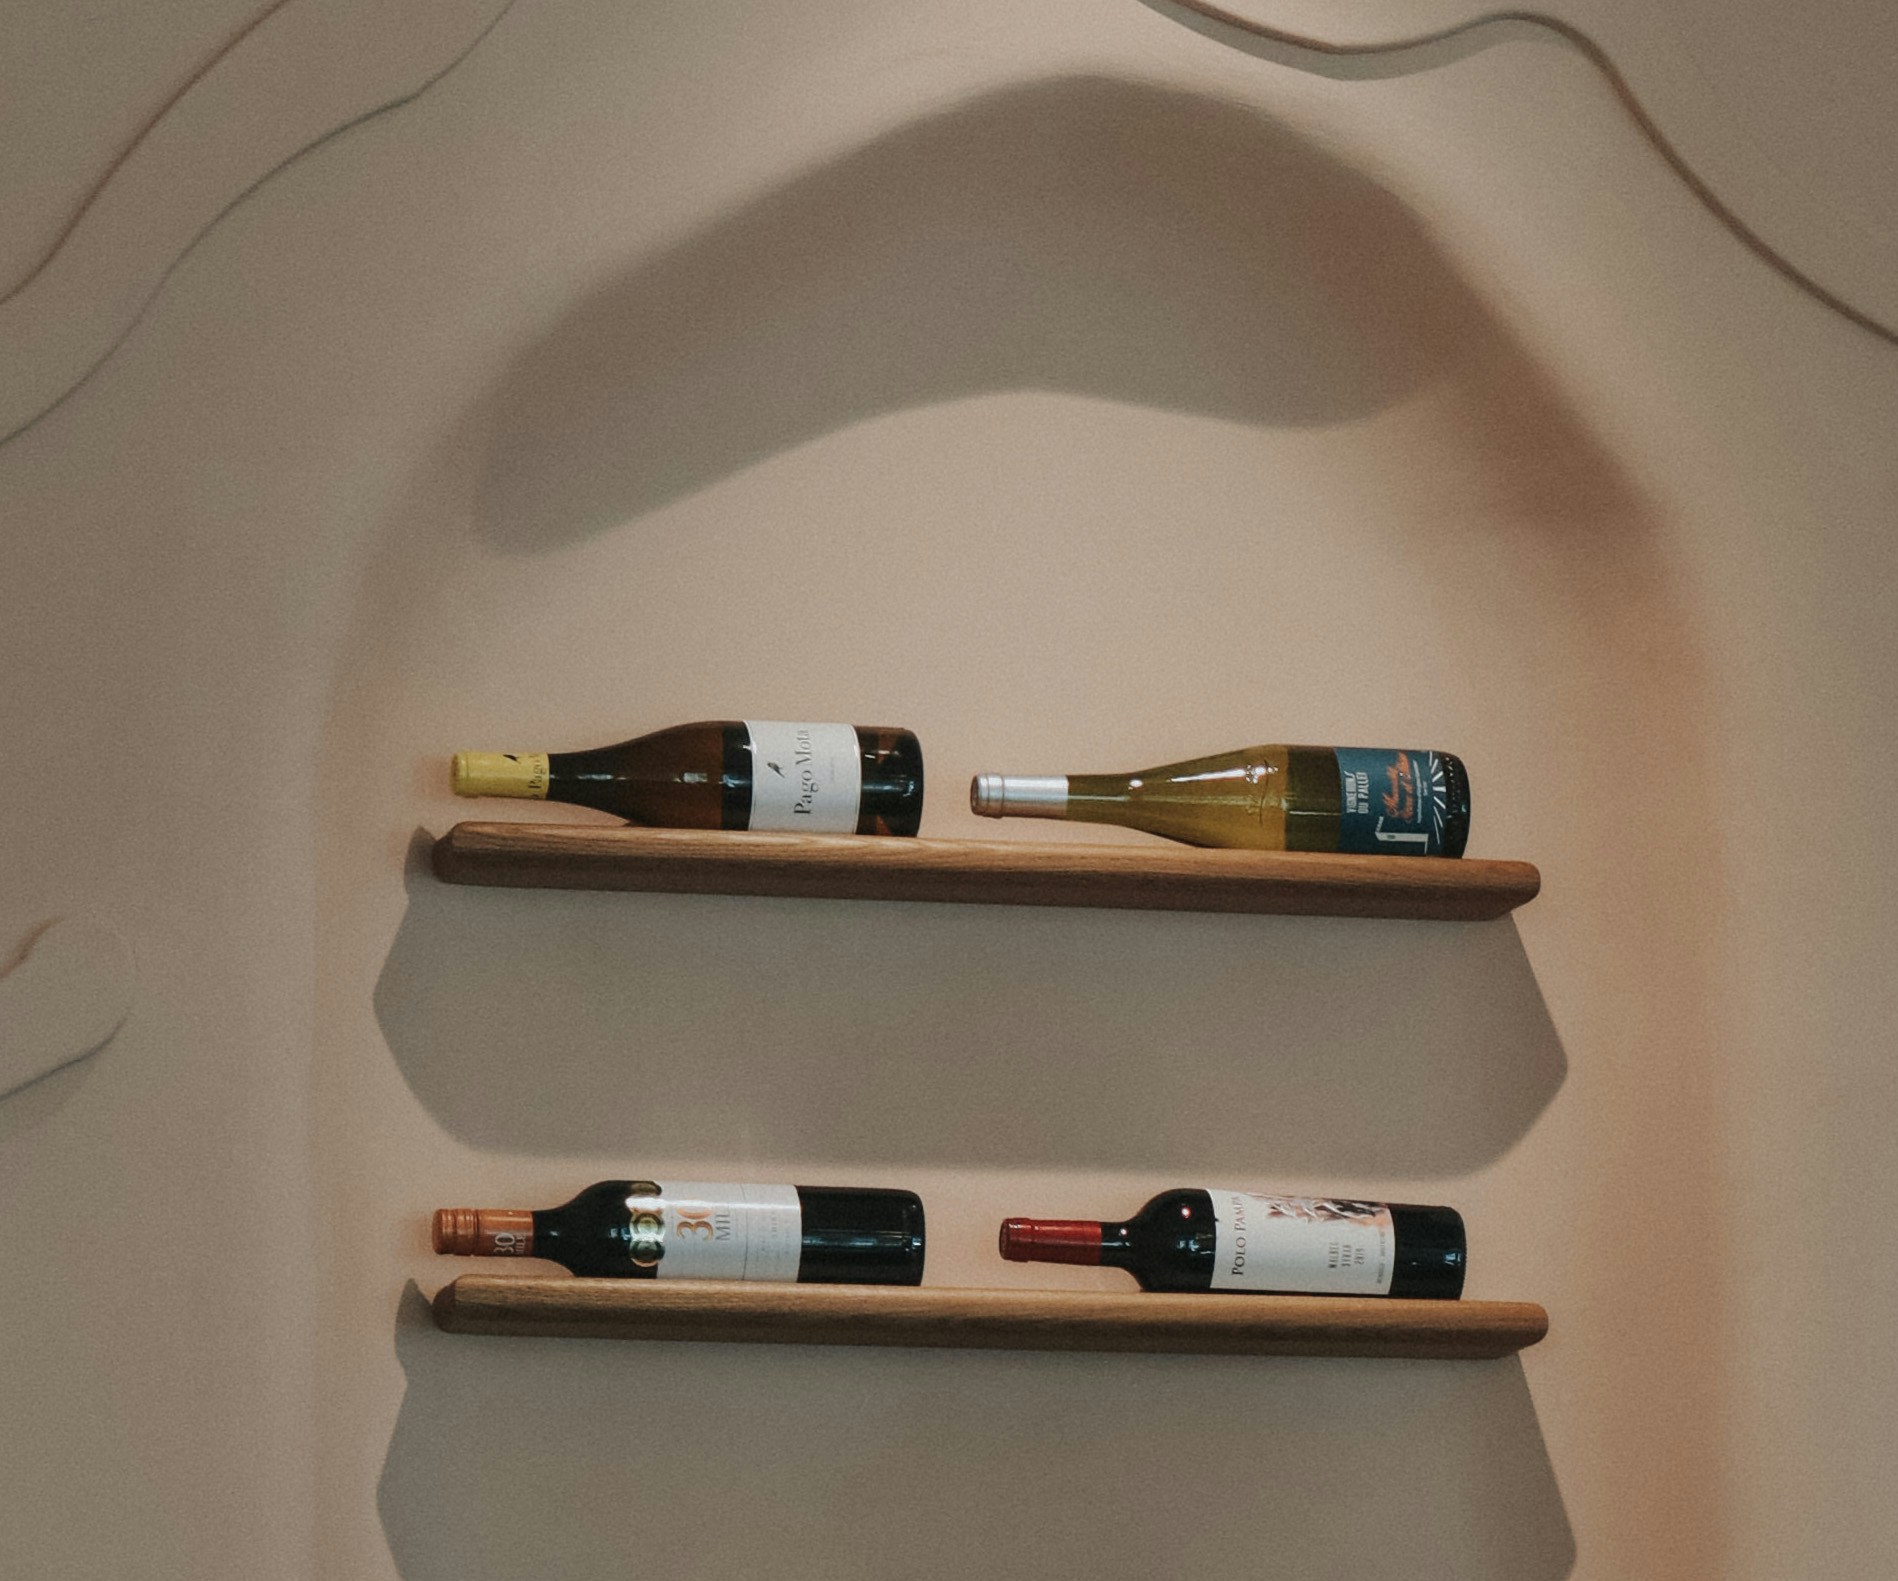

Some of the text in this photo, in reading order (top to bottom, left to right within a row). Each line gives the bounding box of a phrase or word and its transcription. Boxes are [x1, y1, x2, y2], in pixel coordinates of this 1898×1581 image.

[793, 729, 819, 815] Pago Mota
[493, 1232, 516, 1254] 30
[1230, 1196, 1247, 1276] POLO PAMPA
